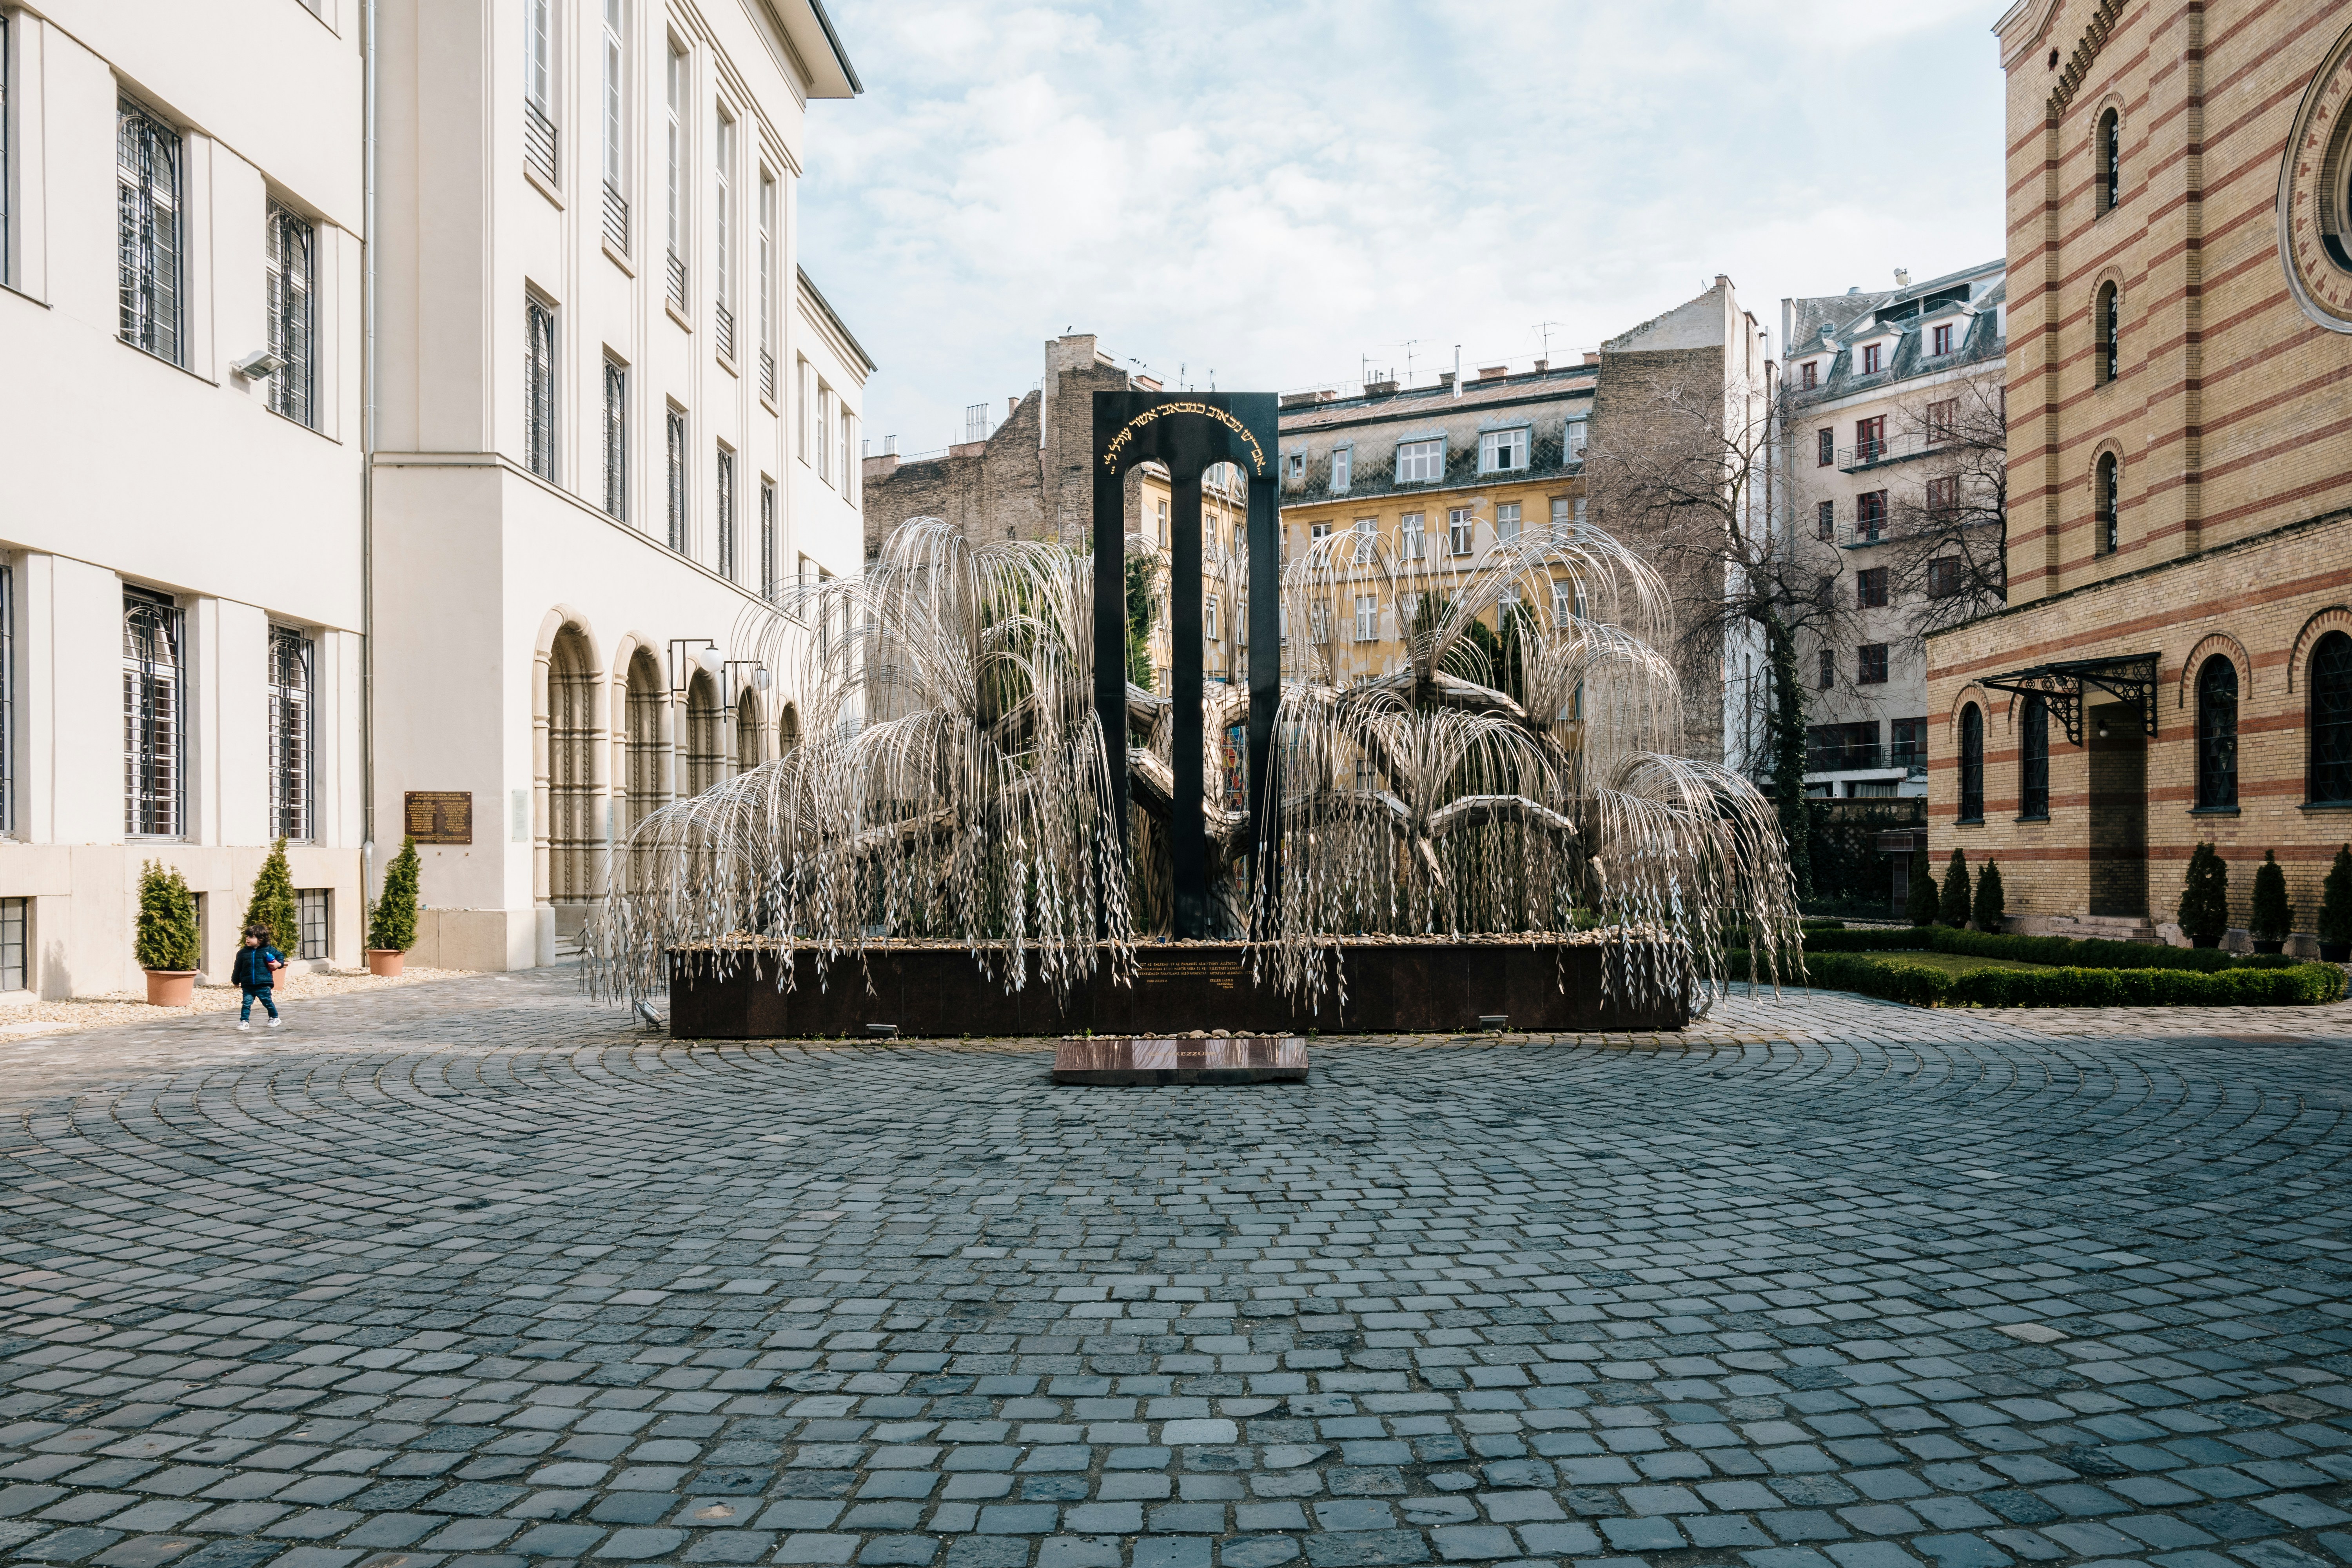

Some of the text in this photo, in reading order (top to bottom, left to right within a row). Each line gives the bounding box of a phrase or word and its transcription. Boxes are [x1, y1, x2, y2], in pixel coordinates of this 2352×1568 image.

[1129, 408, 1158, 427] אשר
[1206, 405, 1243, 432] מכאוב
[1108, 427, 1131, 452] עולל
